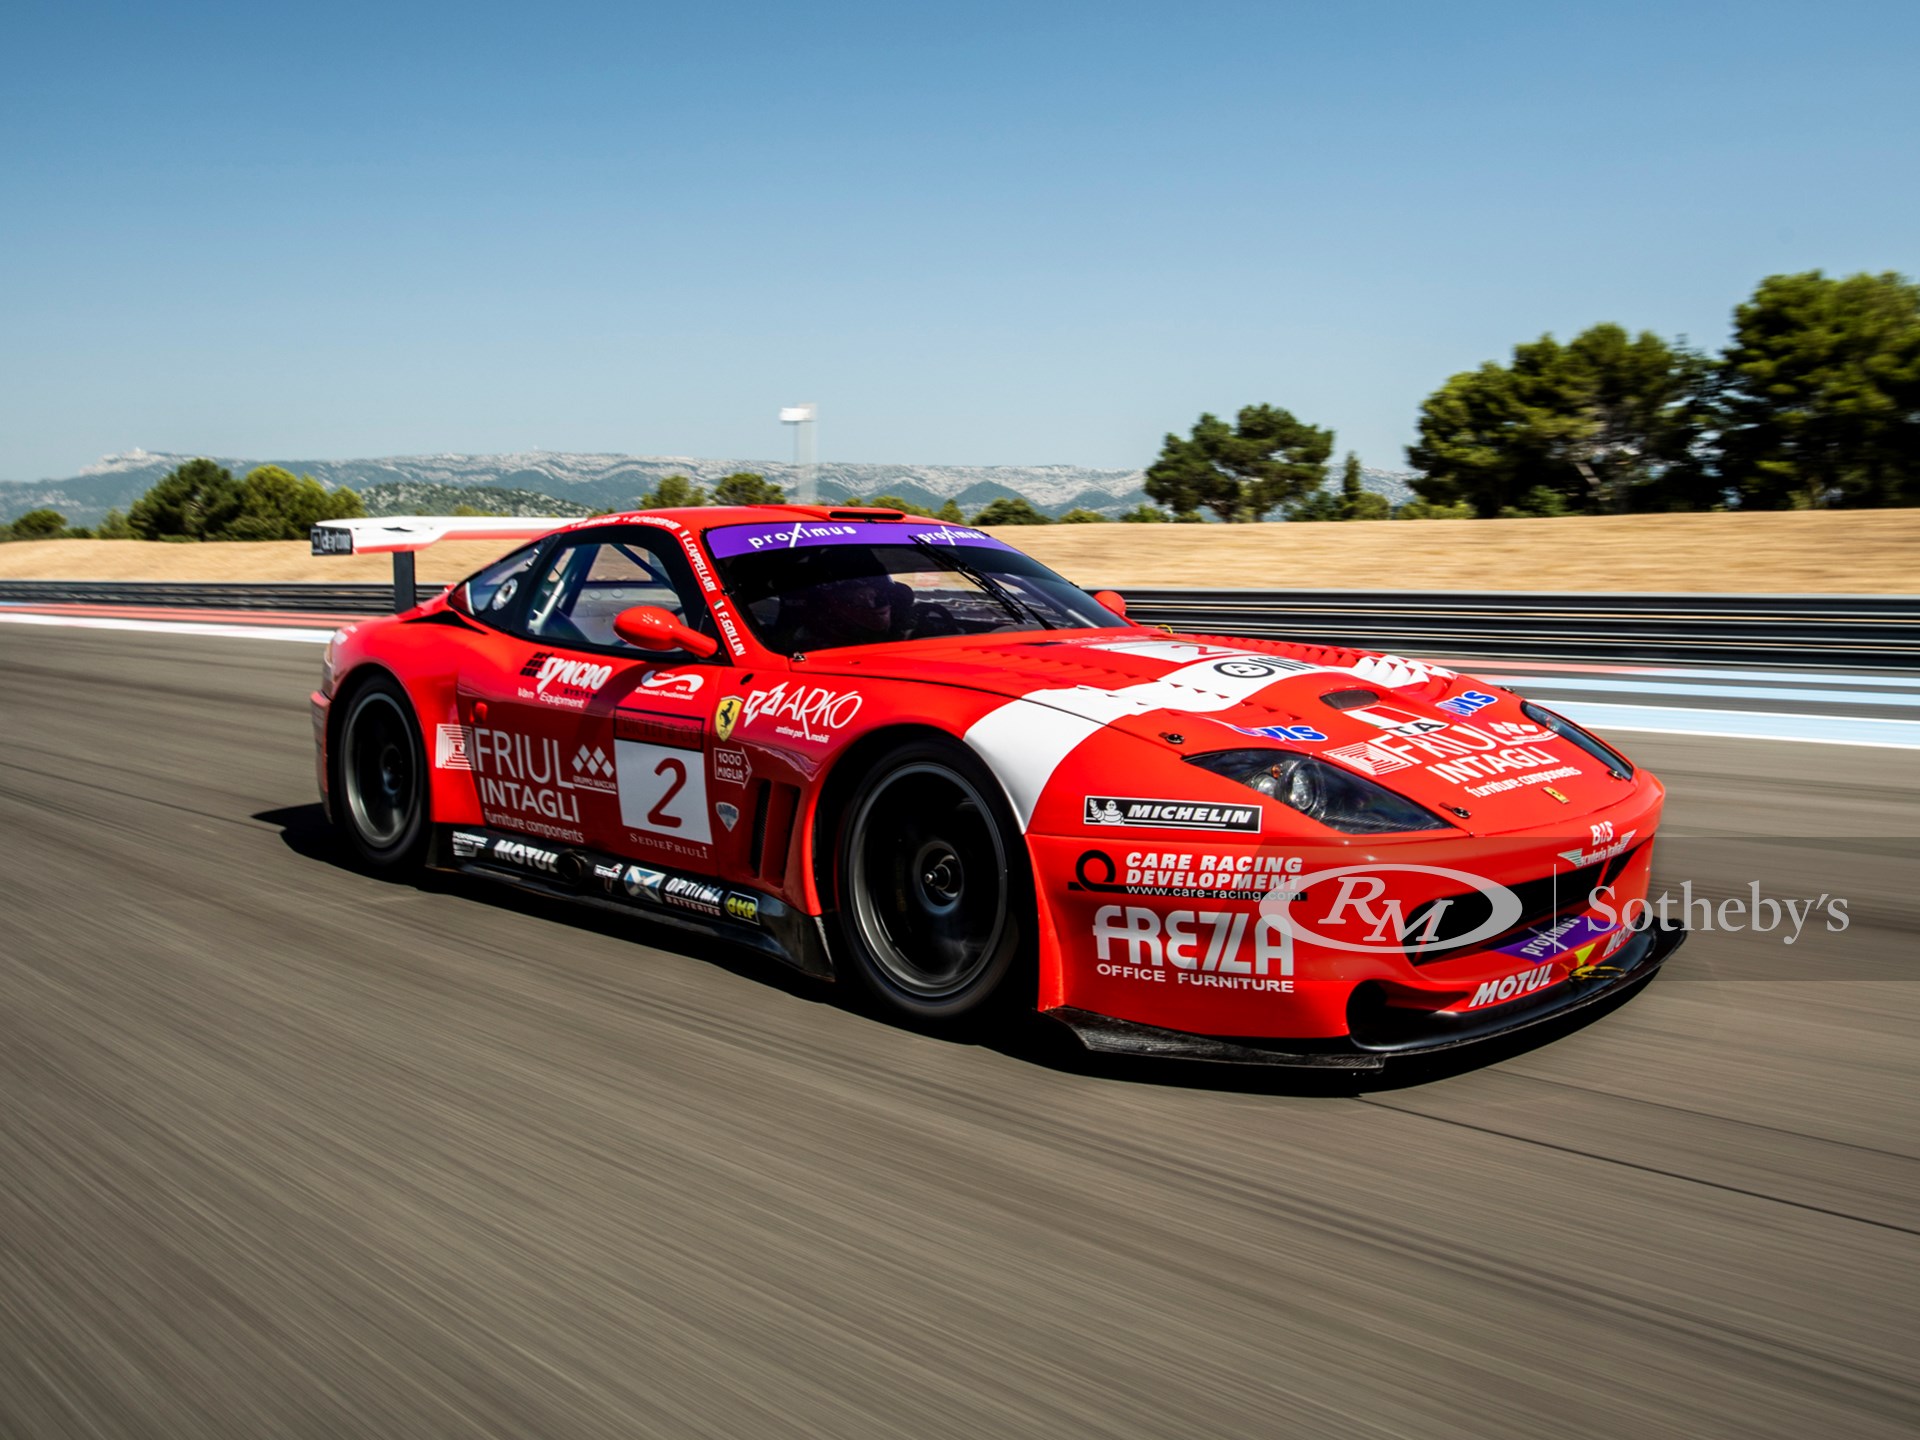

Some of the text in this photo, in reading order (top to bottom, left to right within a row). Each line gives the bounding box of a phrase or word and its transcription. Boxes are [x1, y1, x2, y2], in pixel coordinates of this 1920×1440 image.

[748, 522, 857, 549] proximus
[717, 611, 746, 656] F.GOLLIN
[536, 656, 613, 694] SYNCRO
[517, 687, 584, 708] Van Equipment
[474, 727, 576, 790] FRIUL
[717, 766, 744, 781] MIGLIA
[718, 752, 742, 766] 1000
[1425, 746, 1560, 785] INTAGLI
[647, 757, 687, 829] 2
[1464, 766, 1582, 798] furniture components
[480, 777, 581, 823] INTAGLI
[1127, 804, 1252, 824] MICHELIN
[484, 808, 584, 843] furniture components
[493, 839, 559, 874] MOTUL
[1125, 852, 1303, 873] CARE RACING
[1125, 869, 1303, 890] DEVELOPMENT
[1126, 885, 1302, 902] www.care-racing.com
[665, 896, 721, 917] BATTERIES
[1096, 963, 1295, 993] OFFICE FURNITURE
[1468, 963, 1553, 1008] MOTUL
